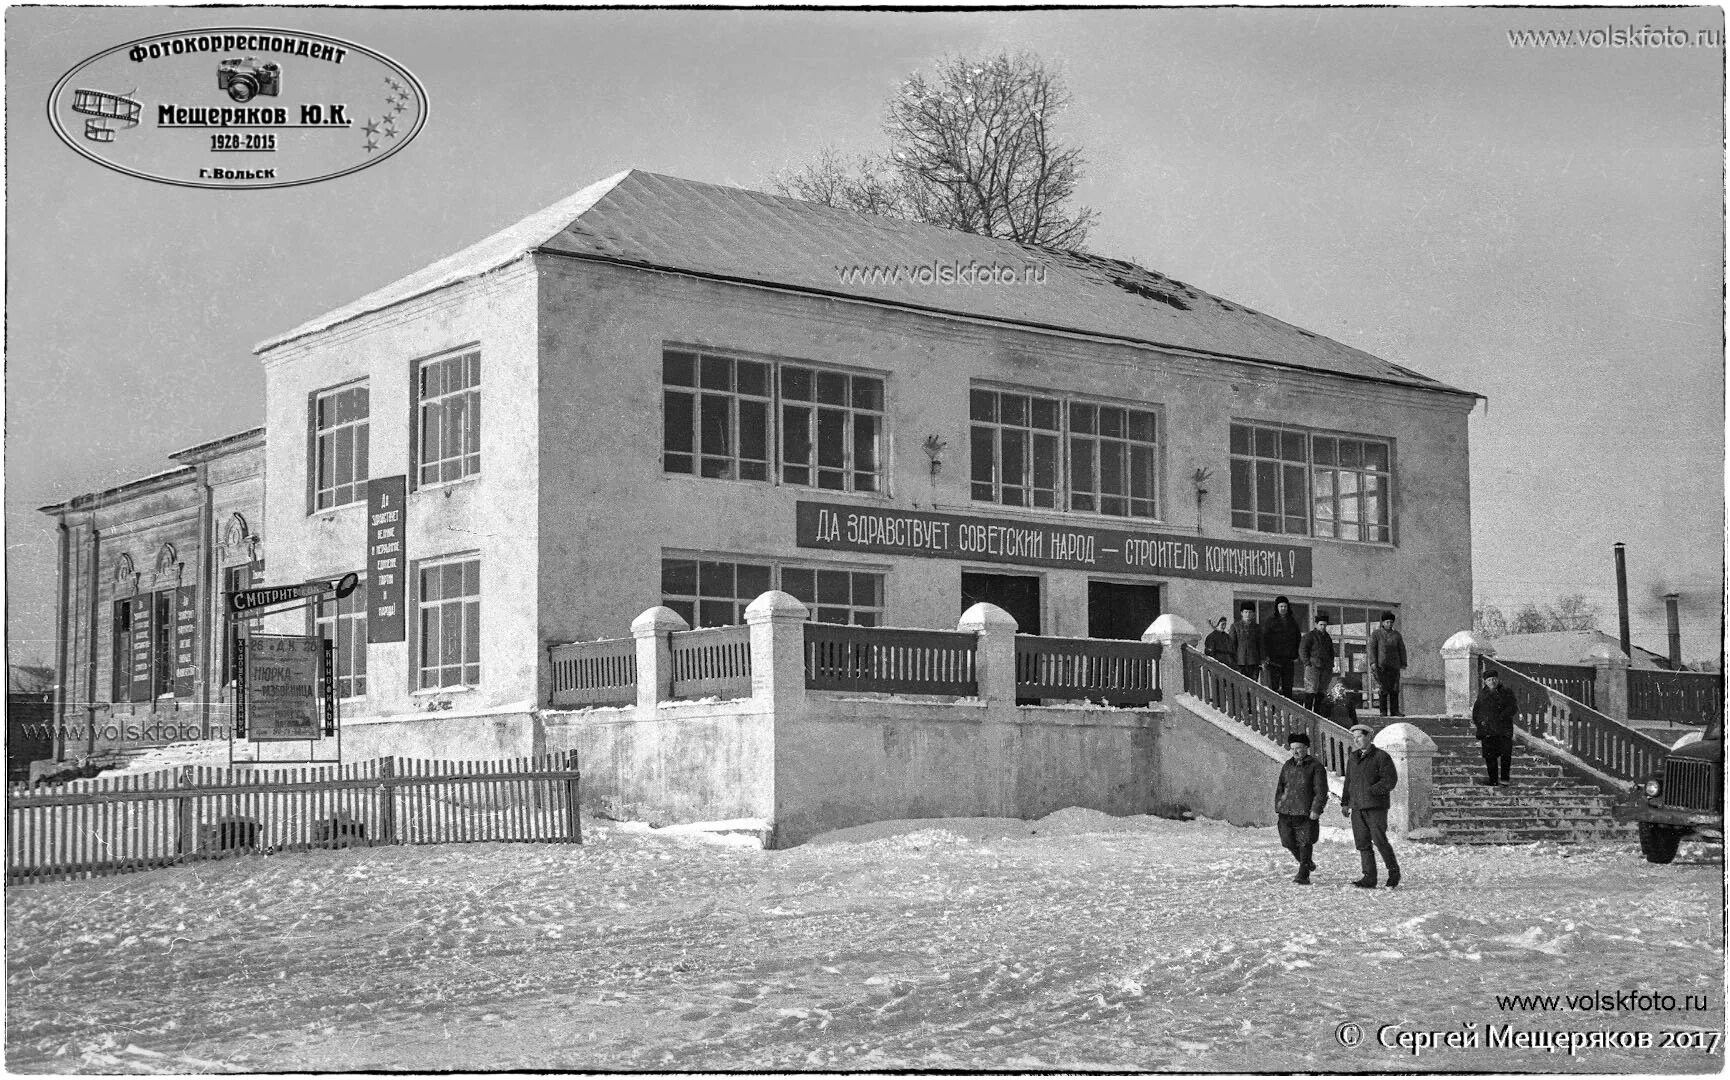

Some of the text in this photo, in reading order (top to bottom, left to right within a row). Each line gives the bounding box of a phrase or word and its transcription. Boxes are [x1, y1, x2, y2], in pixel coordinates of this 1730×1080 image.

[816, 509, 840, 542] ДА
[847, 514, 950, 550] ЗДРАВСТВУЕТ
[1051, 532, 1095, 564] НАРОД
[1125, 538, 1199, 570] СТРОИТЕЛЬ
[234, 587, 298, 610] СМОТРИТЕ
